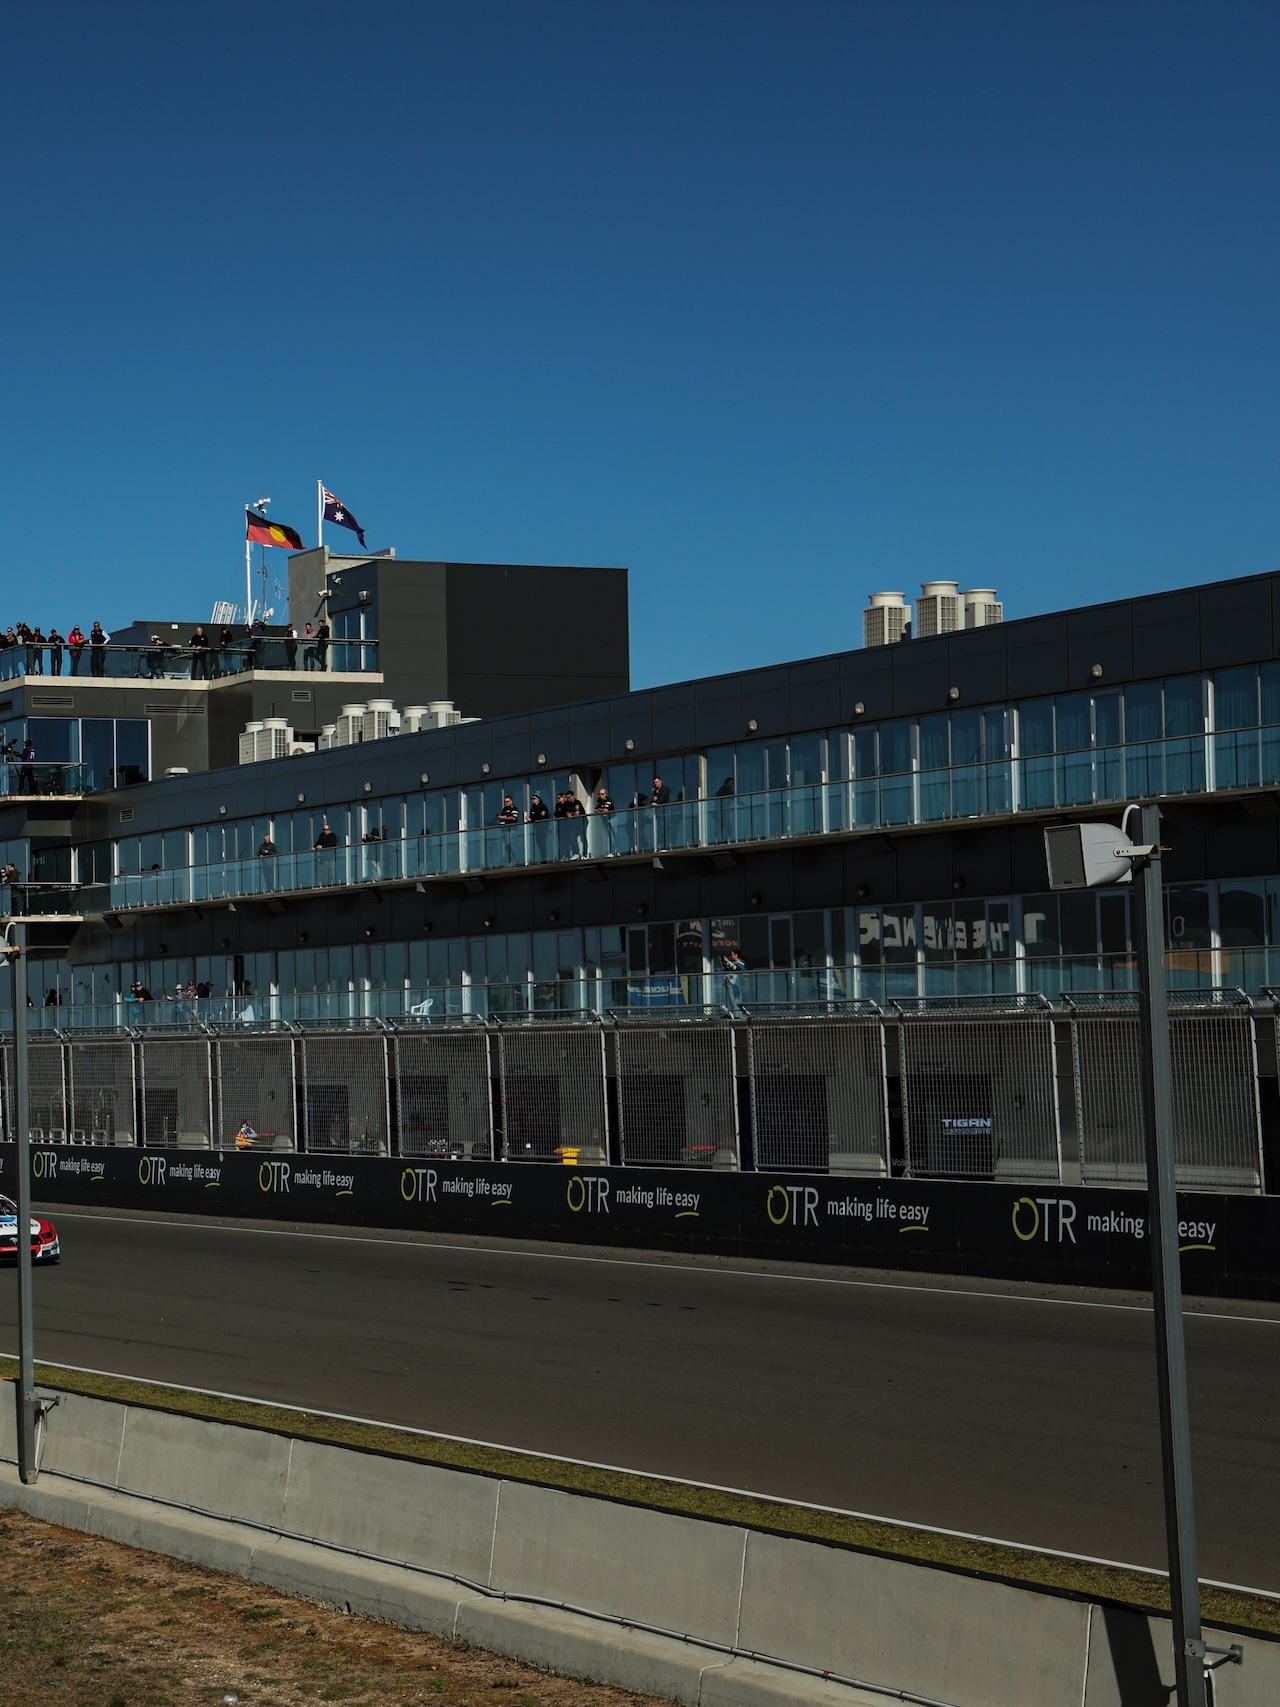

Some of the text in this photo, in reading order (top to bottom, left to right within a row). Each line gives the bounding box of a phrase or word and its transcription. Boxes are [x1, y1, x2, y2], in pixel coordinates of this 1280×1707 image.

[941, 1118, 992, 1128] TIGAN
[33, 1151, 105, 1178] OTR making life easy
[138, 1156, 221, 1185] OTR making life easy
[259, 1161, 354, 1193] OTR making life easy
[401, 1168, 512, 1202] OTR making life easy
[567, 1176, 700, 1213] OTR making life easy
[767, 1185, 930, 1227] OTR making life easy
[1012, 1196, 1077, 1244] OTR
[1087, 1210, 1145, 1239] making
[1178, 1220, 1217, 1244] easy
